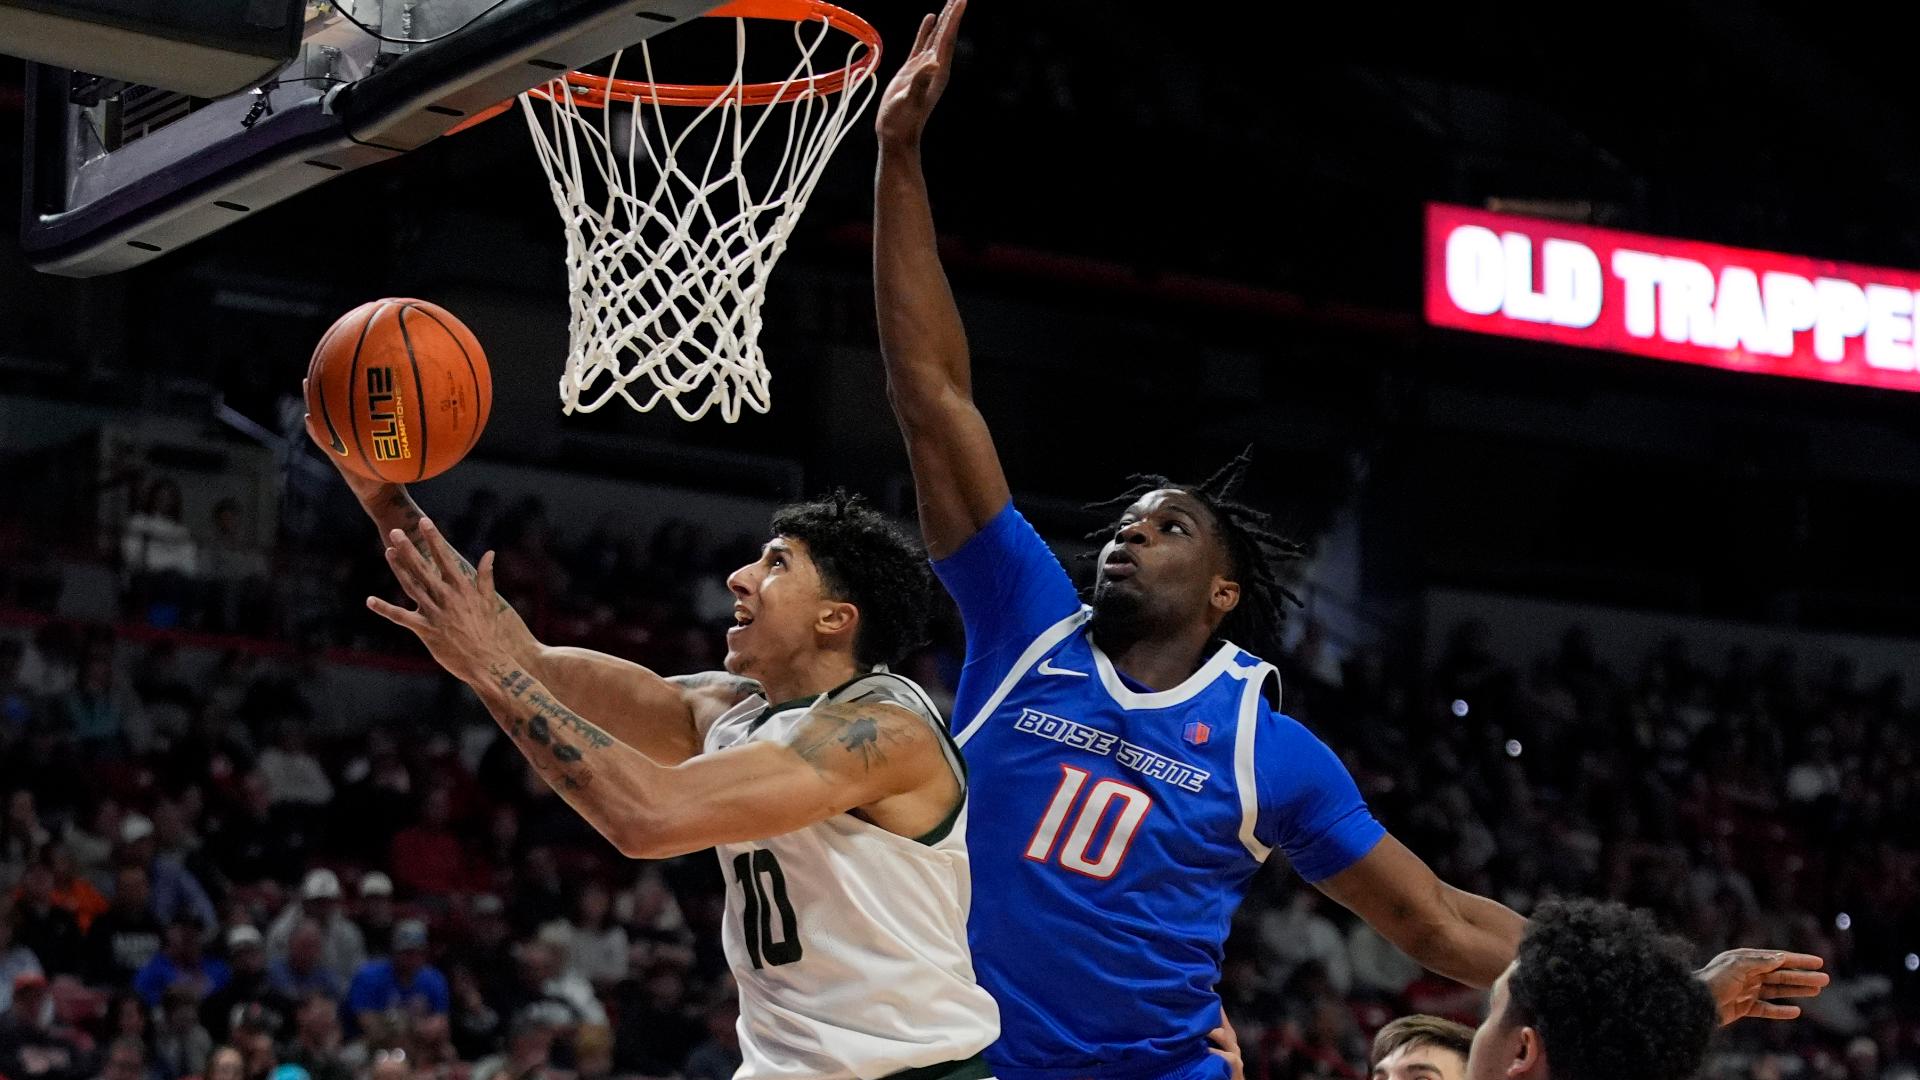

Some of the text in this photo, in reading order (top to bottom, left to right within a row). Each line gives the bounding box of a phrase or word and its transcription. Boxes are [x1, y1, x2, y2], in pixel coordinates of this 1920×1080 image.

[1446, 224, 1920, 373] OLD TRAPPE
[366, 366, 403, 461] ELITE
[1013, 708, 1211, 793] BOISE STATE
[1023, 762, 1153, 881] 10
[733, 848, 803, 970] 10
